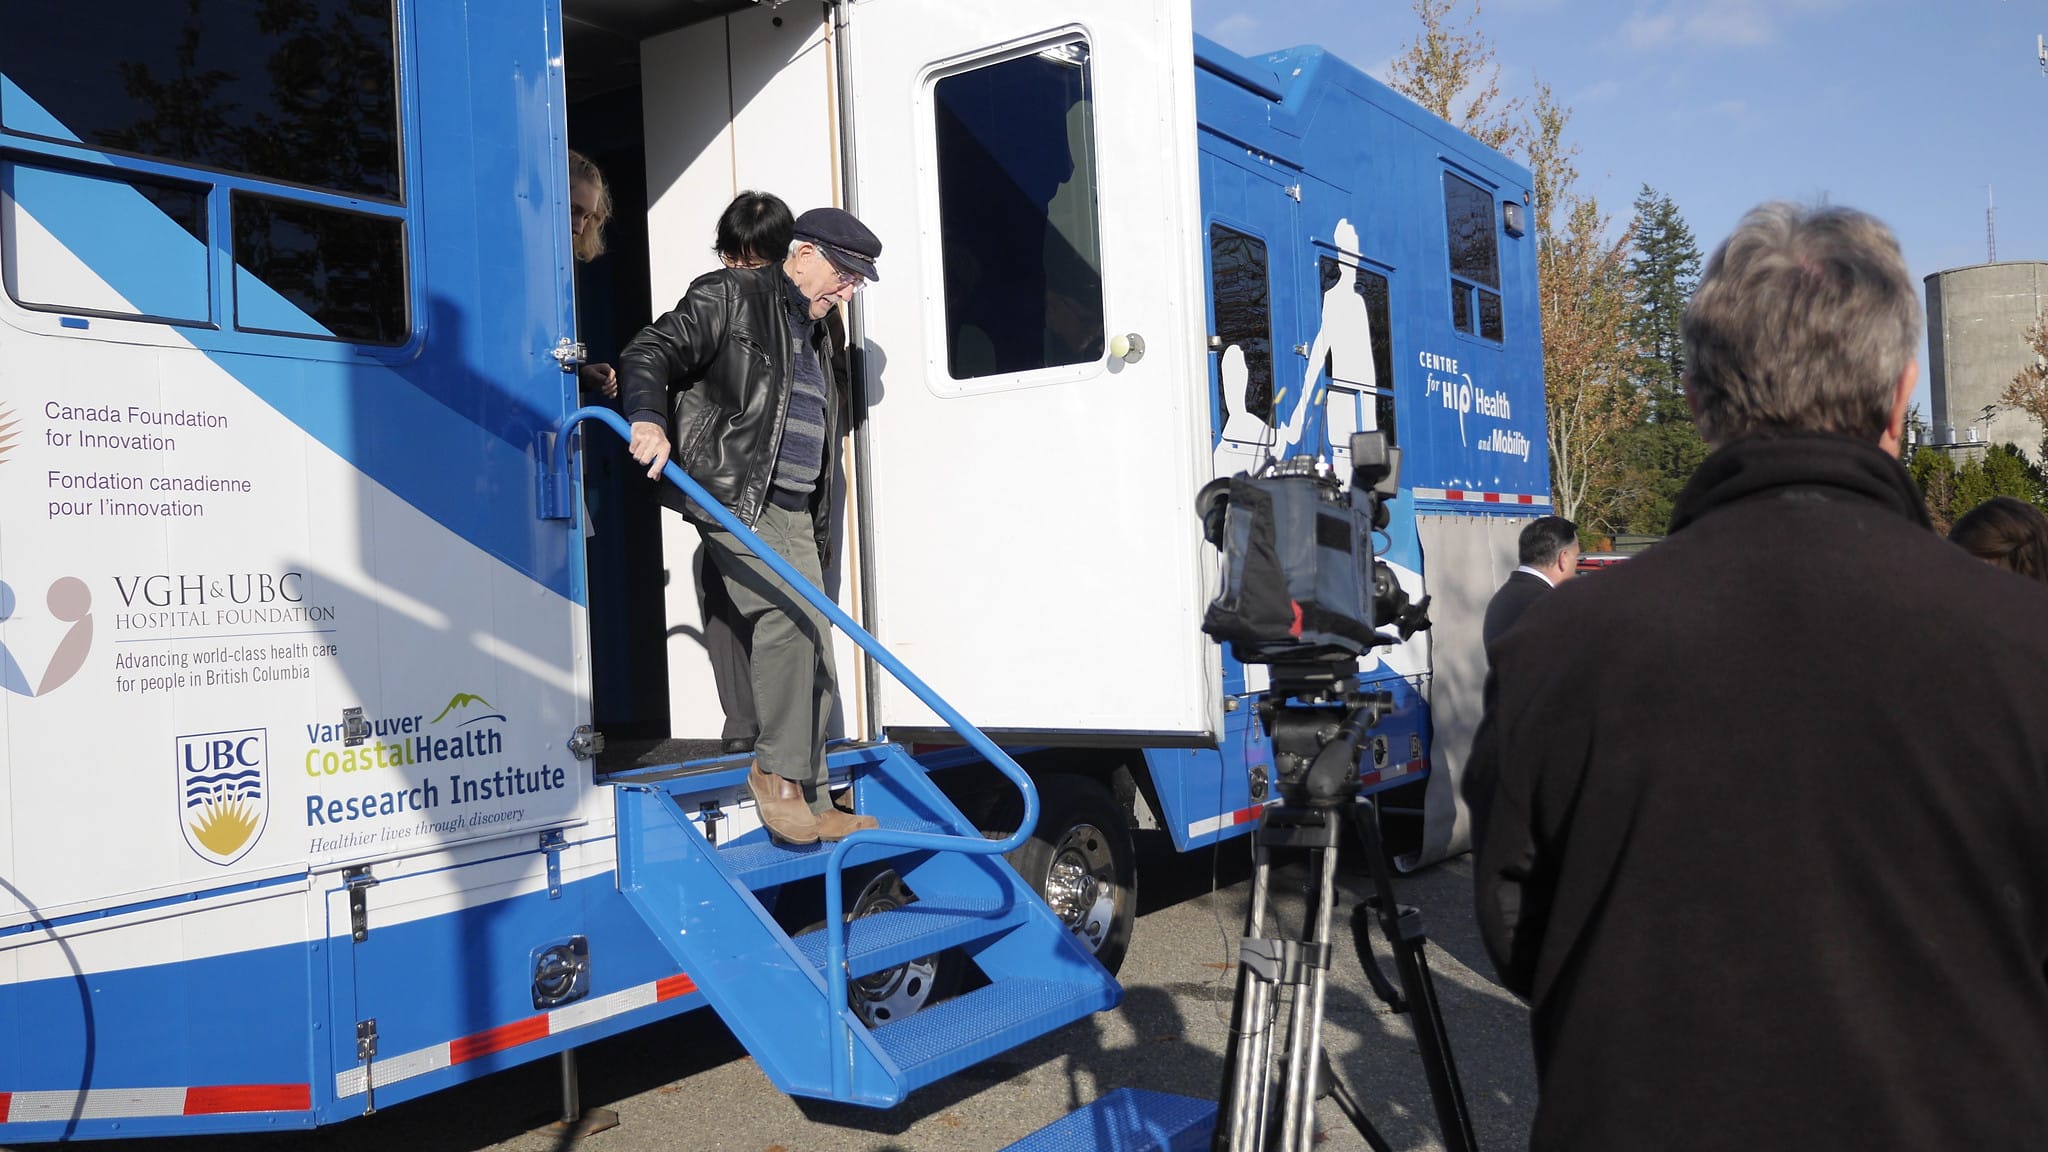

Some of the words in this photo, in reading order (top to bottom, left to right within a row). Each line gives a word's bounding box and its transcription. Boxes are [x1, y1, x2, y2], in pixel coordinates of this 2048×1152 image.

[1419, 351, 1458, 375] CENTRE
[1425, 372, 1440, 397] for
[1475, 387, 1511, 419] Health
[45, 401, 121, 423] Canada
[128, 406, 228, 428] Foundation
[46, 429, 72, 447] for
[79, 430, 175, 451] Innovation
[1477, 435, 1491, 452] and
[1492, 428, 1530, 462] Mobility
[48, 471, 143, 490] Fondation
[150, 475, 251, 492] canadienne
[49, 500, 92, 519] pour
[116, 611, 210, 630] HOSPITAL
[217, 606, 335, 625] FOUNDATION
[115, 650, 189, 669] Advancing
[193, 645, 267, 664] world-class
[271, 642, 309, 660] health
[312, 643, 337, 656] care
[116, 677, 135, 692] for
[140, 673, 185, 693] people
[189, 670, 201, 687] in
[206, 666, 249, 686] British
[252, 663, 310, 682] Columbia
[307, 715, 423, 744] Vanouver
[185, 737, 259, 772] UBC
[307, 777, 439, 826] Research
[450, 763, 565, 805] Institute
[309, 832, 378, 853] Healthier
[380, 825, 411, 841] lives
[415, 814, 466, 834] through
[469, 808, 525, 826] discovery
